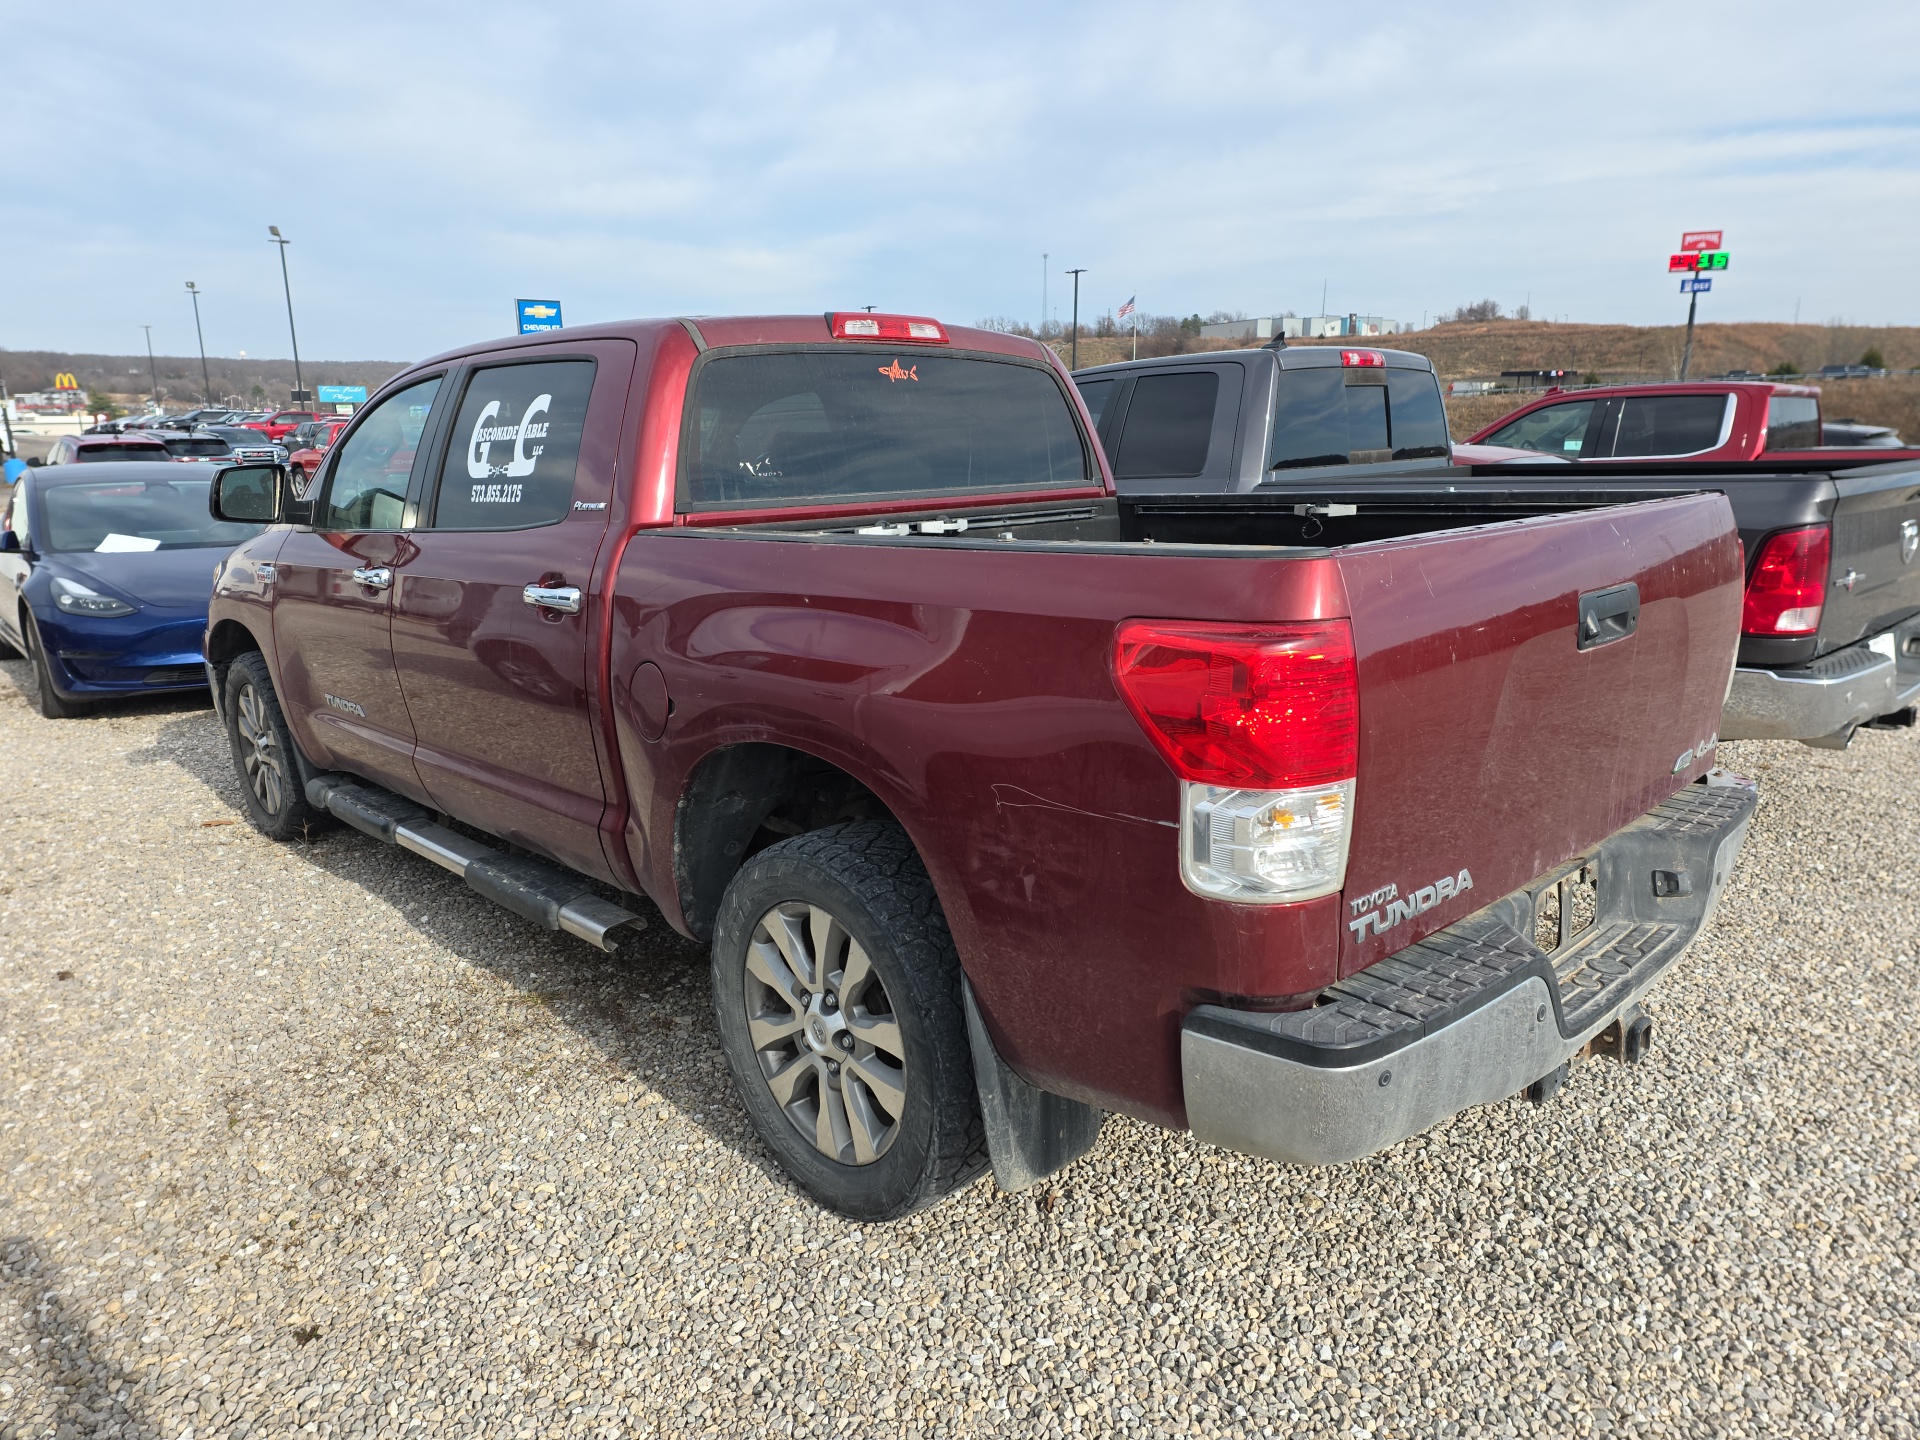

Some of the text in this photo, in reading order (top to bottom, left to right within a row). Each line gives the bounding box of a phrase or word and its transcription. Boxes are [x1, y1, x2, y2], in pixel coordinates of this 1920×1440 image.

[532, 445, 544, 456] LLC
[470, 484, 523, 503] 573.855.2175
[324, 692, 367, 718] TUNDRA
[1348, 868, 1474, 944] TUNDRA
[1349, 883, 1399, 917] TOYOTA
